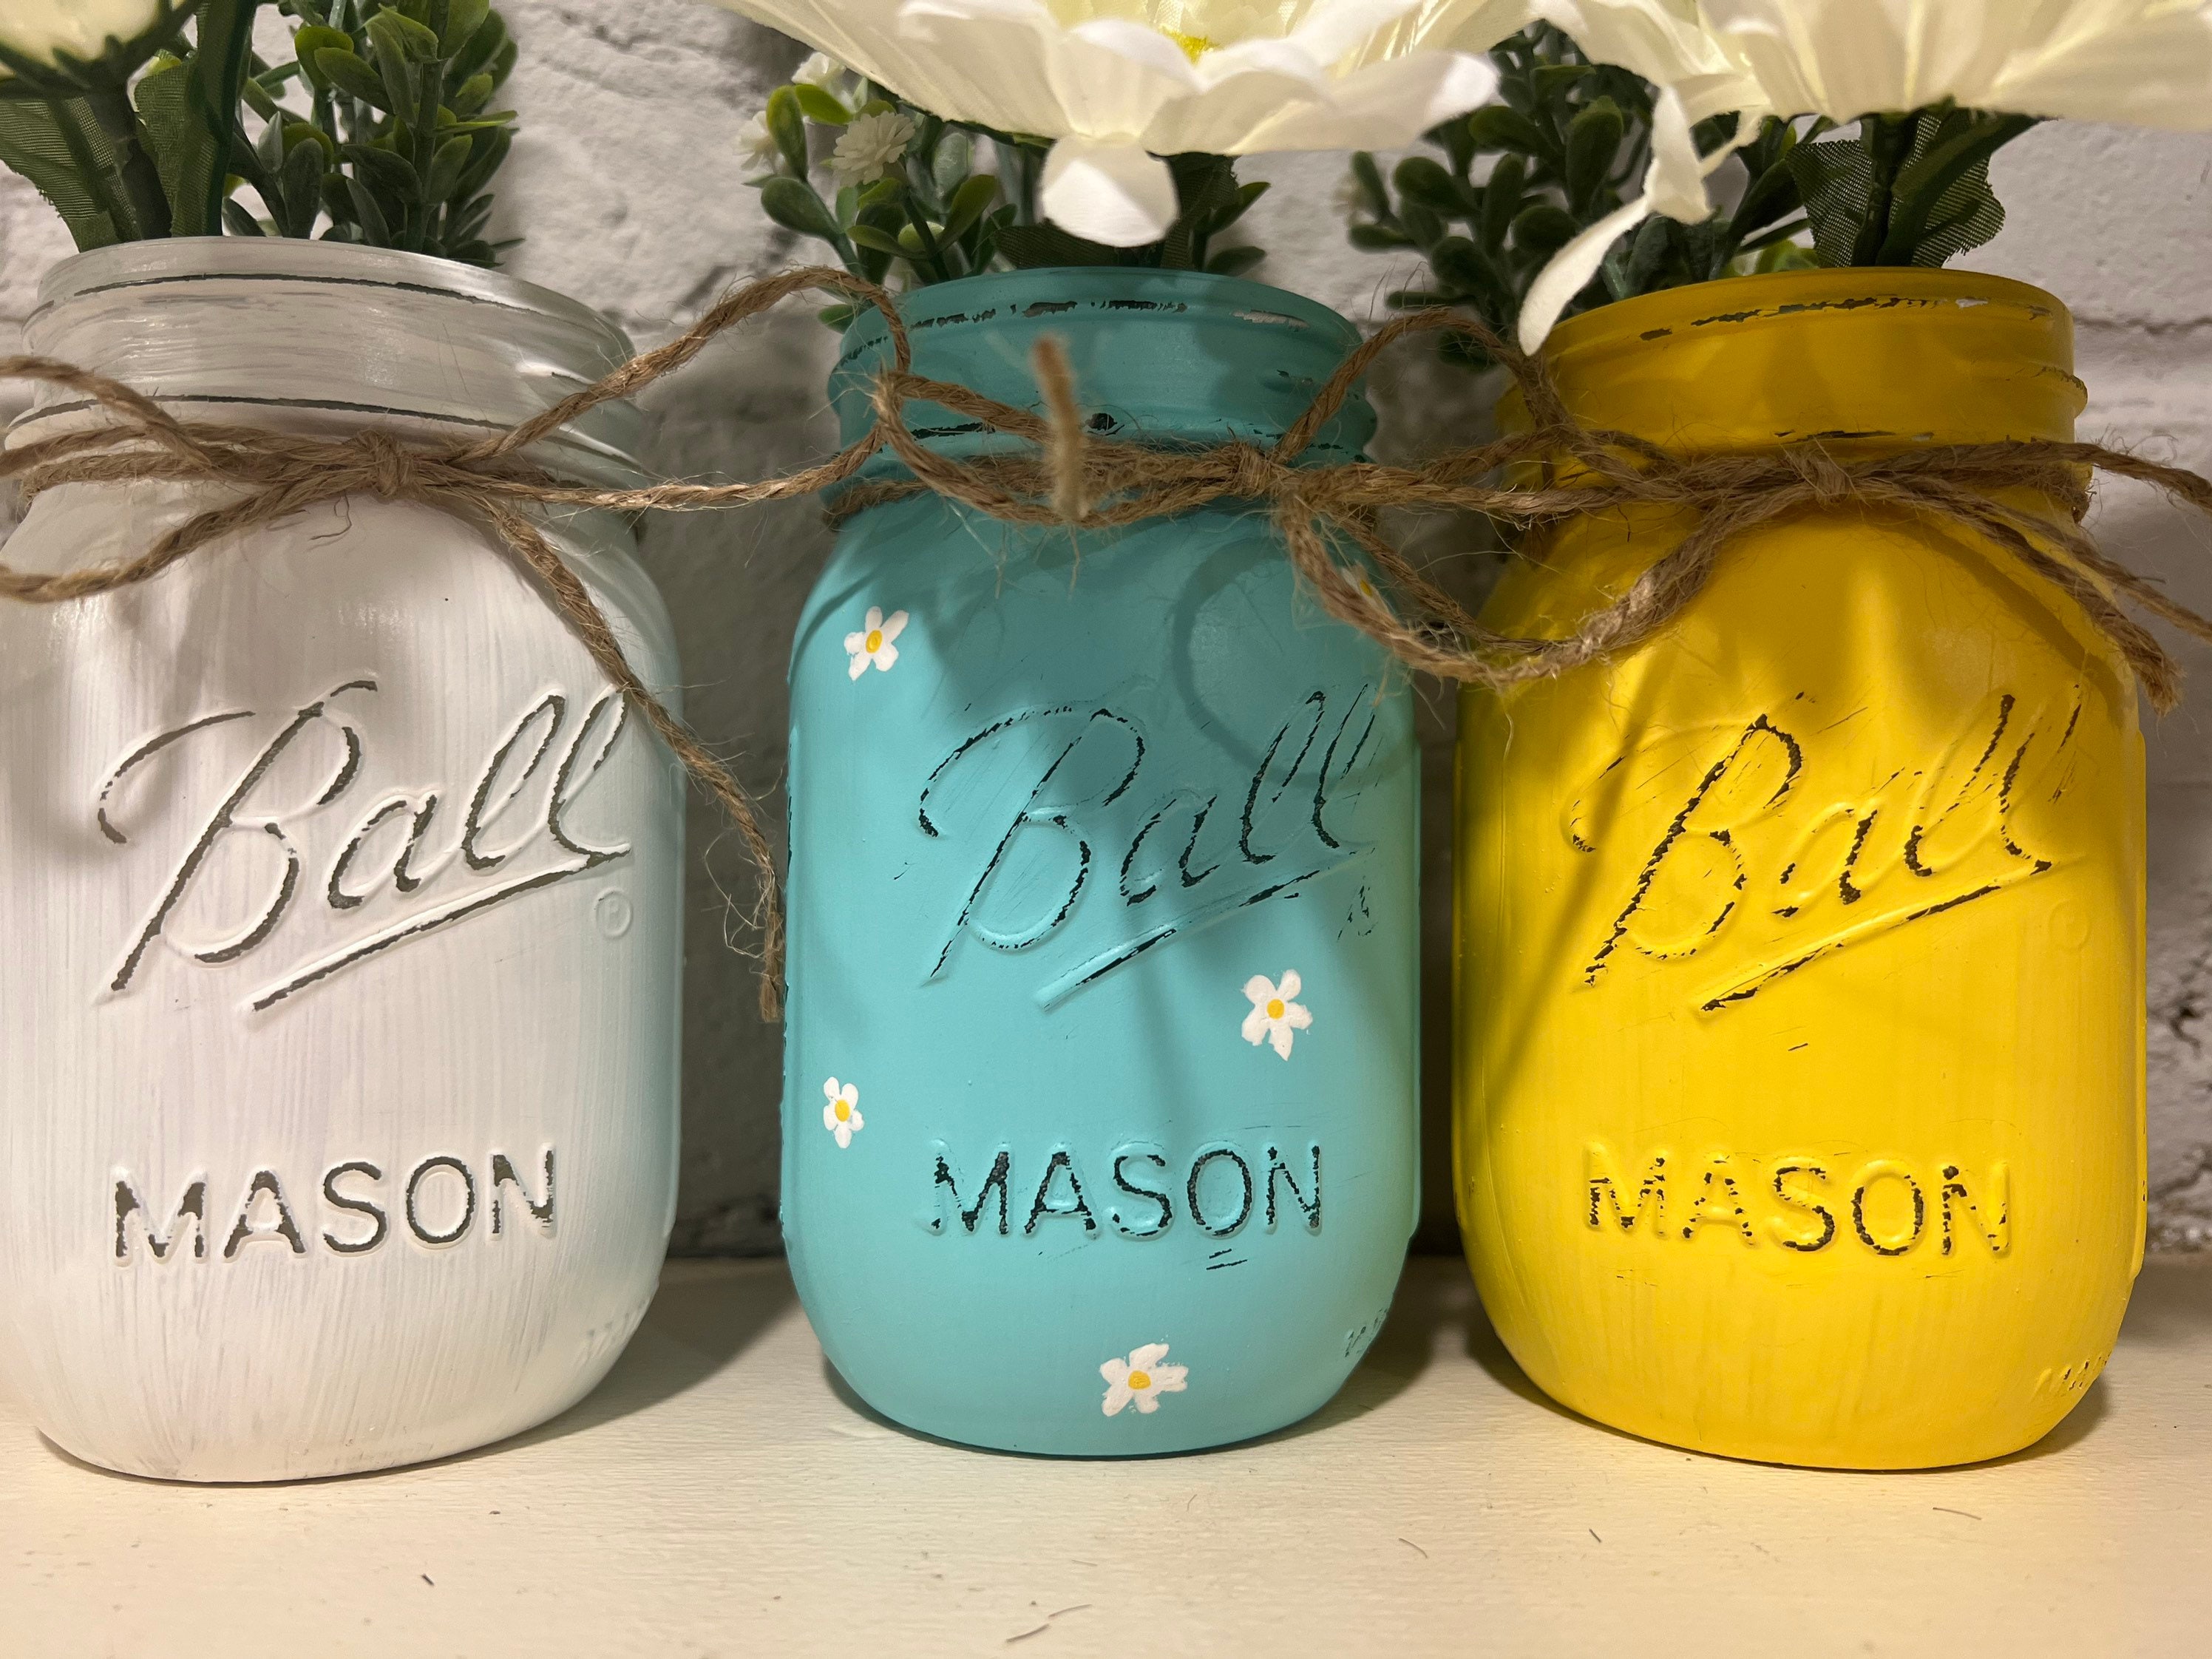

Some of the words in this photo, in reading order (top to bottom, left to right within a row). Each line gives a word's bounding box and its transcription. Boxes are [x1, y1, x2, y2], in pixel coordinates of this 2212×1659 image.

[93, 674, 630, 1005] Ball
[917, 679, 1377, 989] Ball
[1562, 683, 2081, 994] Ball
[112, 1142, 558, 1266] MASON
[927, 1138, 1323, 1240] MASON
[1583, 1139, 2013, 1258] MASON
